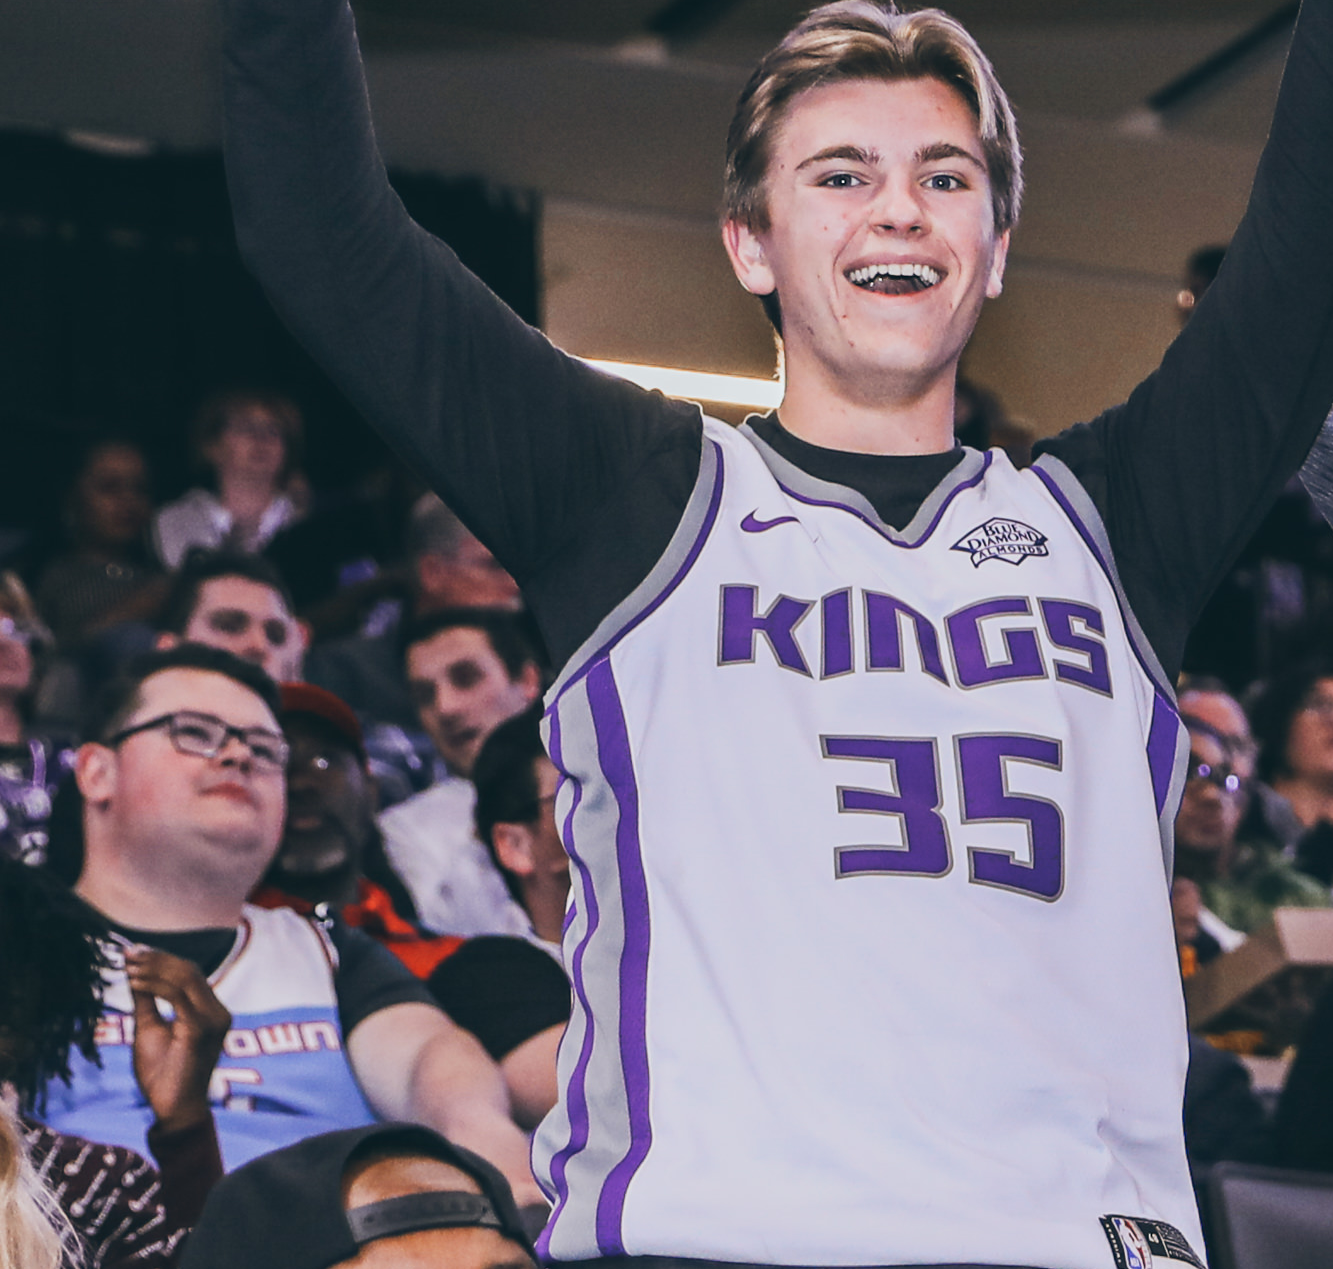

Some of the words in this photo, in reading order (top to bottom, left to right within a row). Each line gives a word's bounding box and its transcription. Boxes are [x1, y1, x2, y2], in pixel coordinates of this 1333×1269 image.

[967, 530, 1039, 550] DIAMOND
[982, 523, 1018, 537] BLUE
[979, 544, 1044, 559] ALMONDS
[717, 583, 1114, 699] KINGS
[819, 732, 1065, 903] 35
